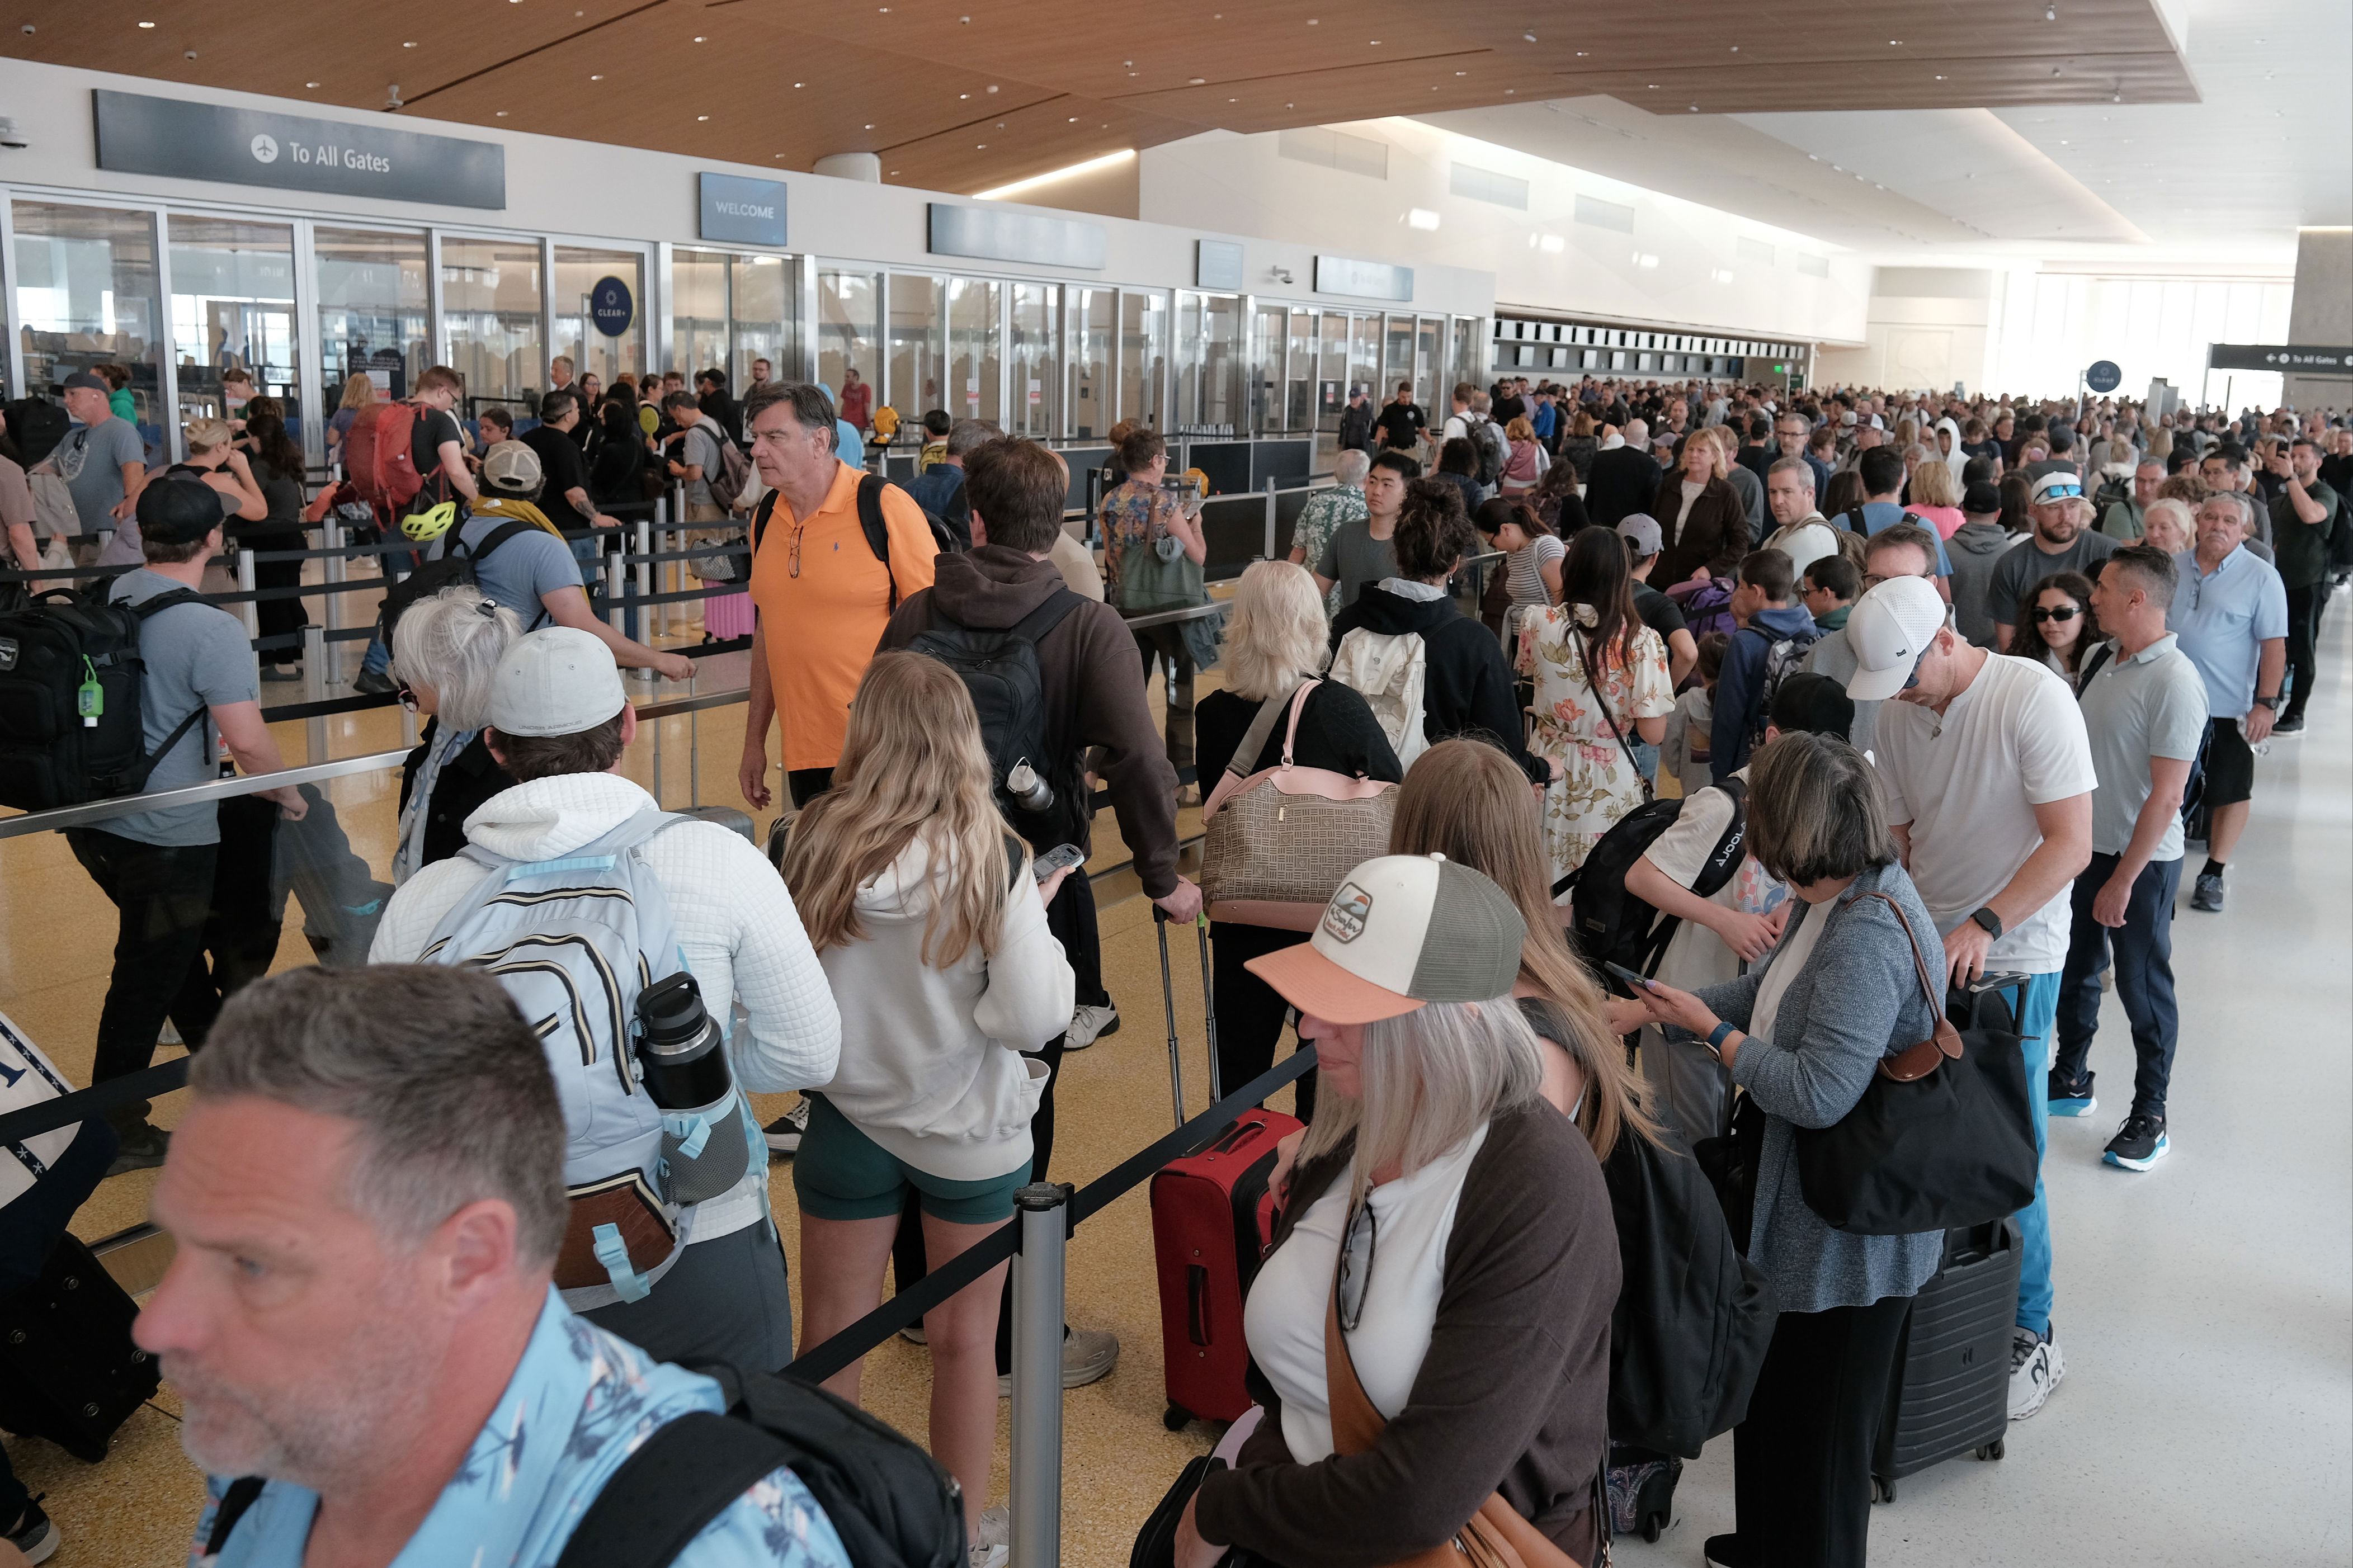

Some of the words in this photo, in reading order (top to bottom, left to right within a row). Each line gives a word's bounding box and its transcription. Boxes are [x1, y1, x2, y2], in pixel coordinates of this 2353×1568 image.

[289, 141, 310, 163] To
[315, 145, 338, 167] All
[344, 149, 390, 173] Gates
[715, 201, 774, 219] WELCOME
[2293, 355, 2302, 364] To
[2303, 355, 2315, 364] All
[2314, 355, 2338, 365] Gates
[547, 720, 582, 730] ARMOUR
